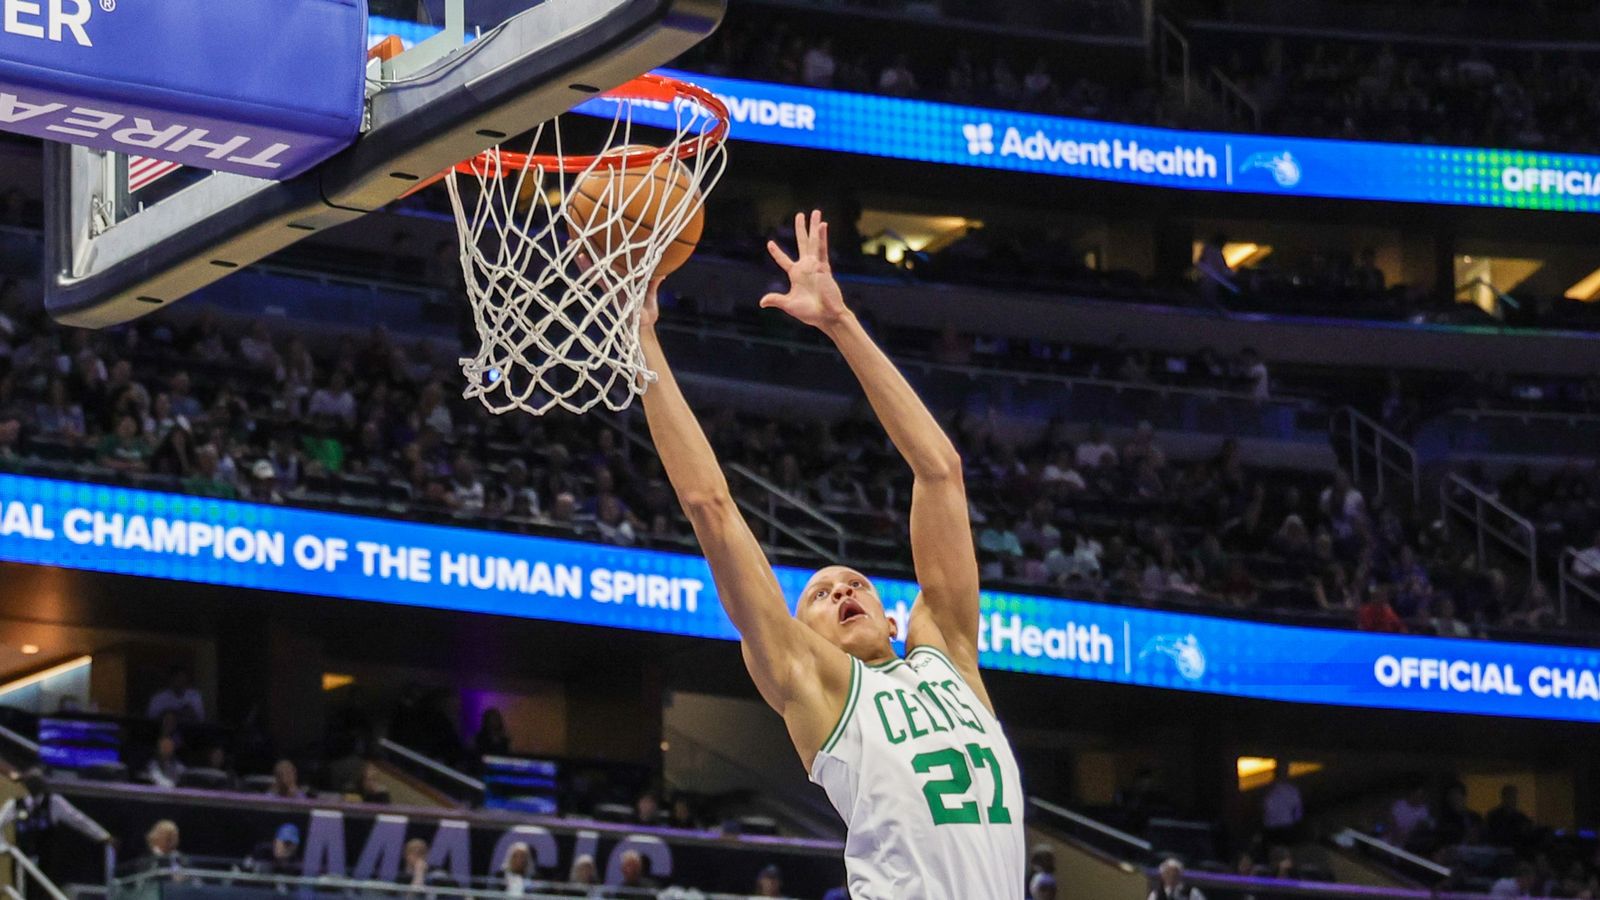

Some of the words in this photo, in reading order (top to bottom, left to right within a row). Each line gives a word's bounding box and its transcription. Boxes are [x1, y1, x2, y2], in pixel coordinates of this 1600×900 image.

[0, 500, 55, 541] AL
[63, 507, 284, 566] CHAMPION
[293, 534, 348, 573] OF
[356, 541, 431, 583] THE
[440, 551, 582, 599] HUMAN
[590, 568, 703, 613] SPIRIT
[1374, 655, 1522, 696] OFFICIAL
[1528, 666, 1600, 701] CHA
[911, 742, 1012, 826] 27
